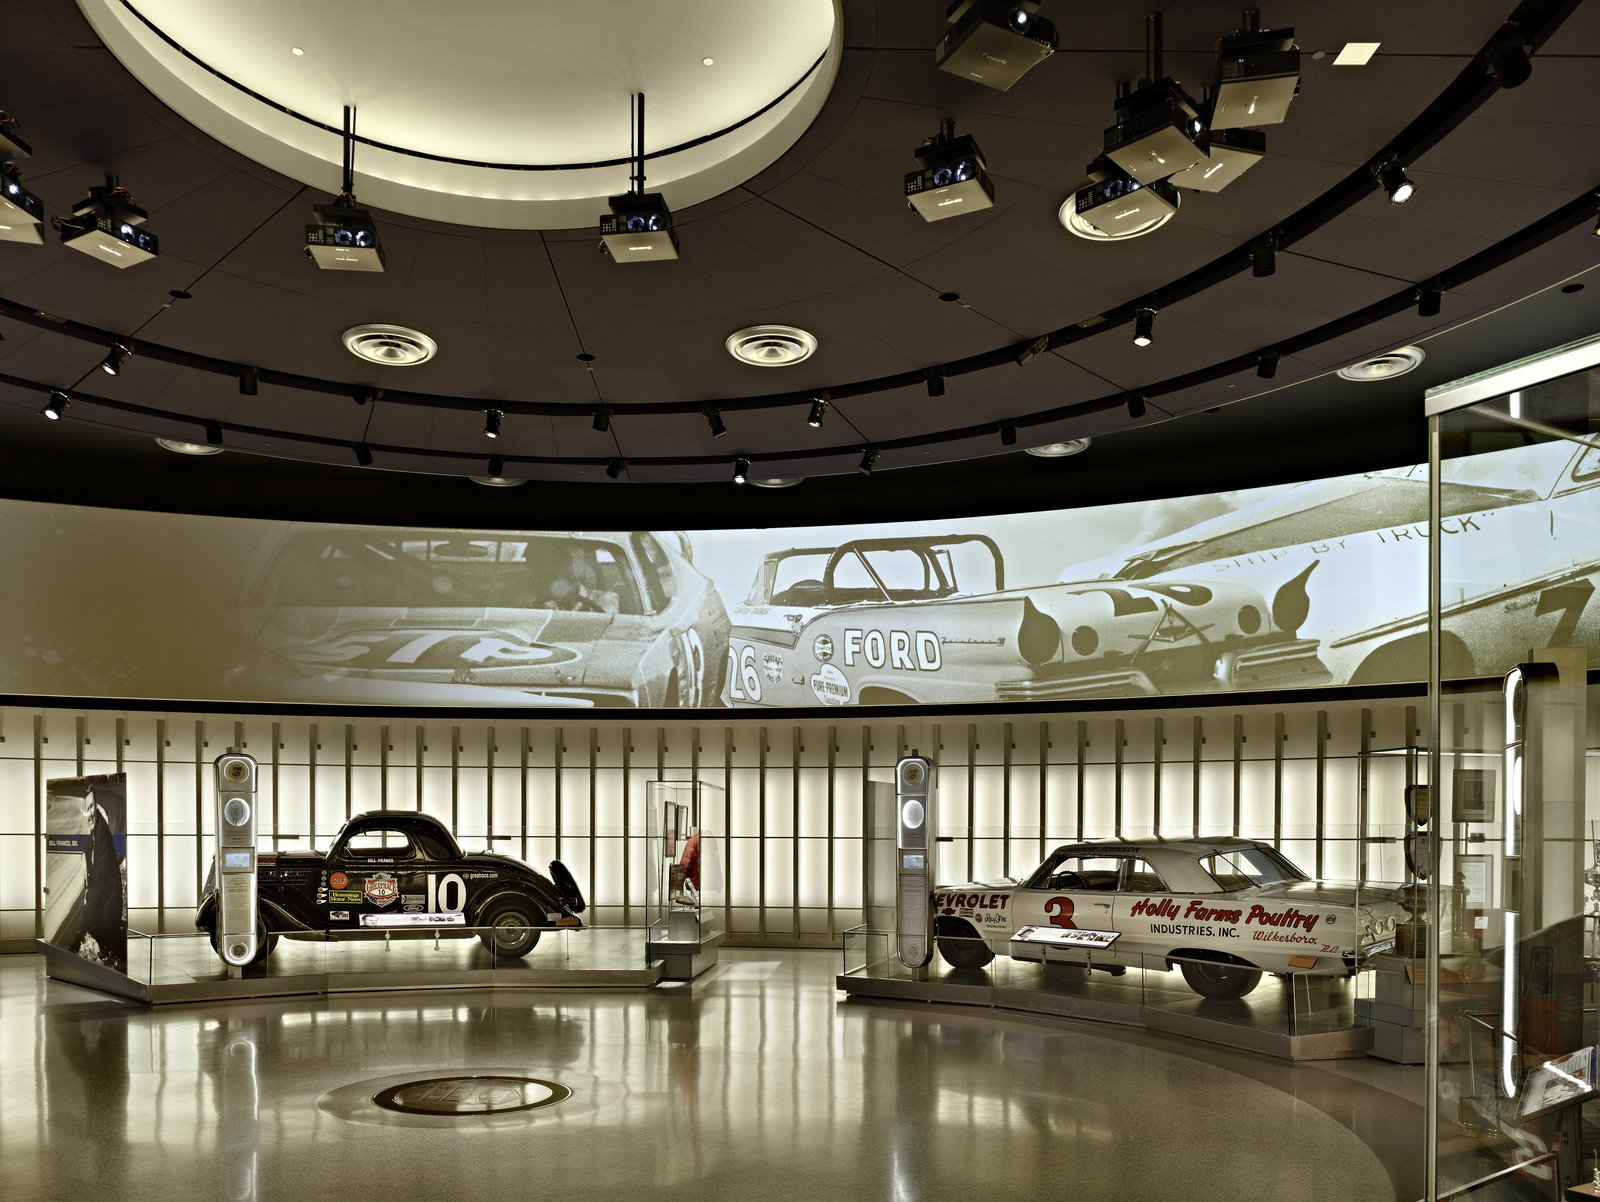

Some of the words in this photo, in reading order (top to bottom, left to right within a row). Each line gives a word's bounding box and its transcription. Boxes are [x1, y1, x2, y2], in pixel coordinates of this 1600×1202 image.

[844, 628, 942, 672] FORD
[427, 873, 467, 914] 10
[935, 893, 1010, 909] EVROLET
[1044, 896, 1077, 950] 3
[1130, 897, 1181, 921] Holly
[1184, 900, 1242, 924] Farms
[1245, 904, 1319, 933] Poultry
[1218, 927, 1240, 938] INC.
